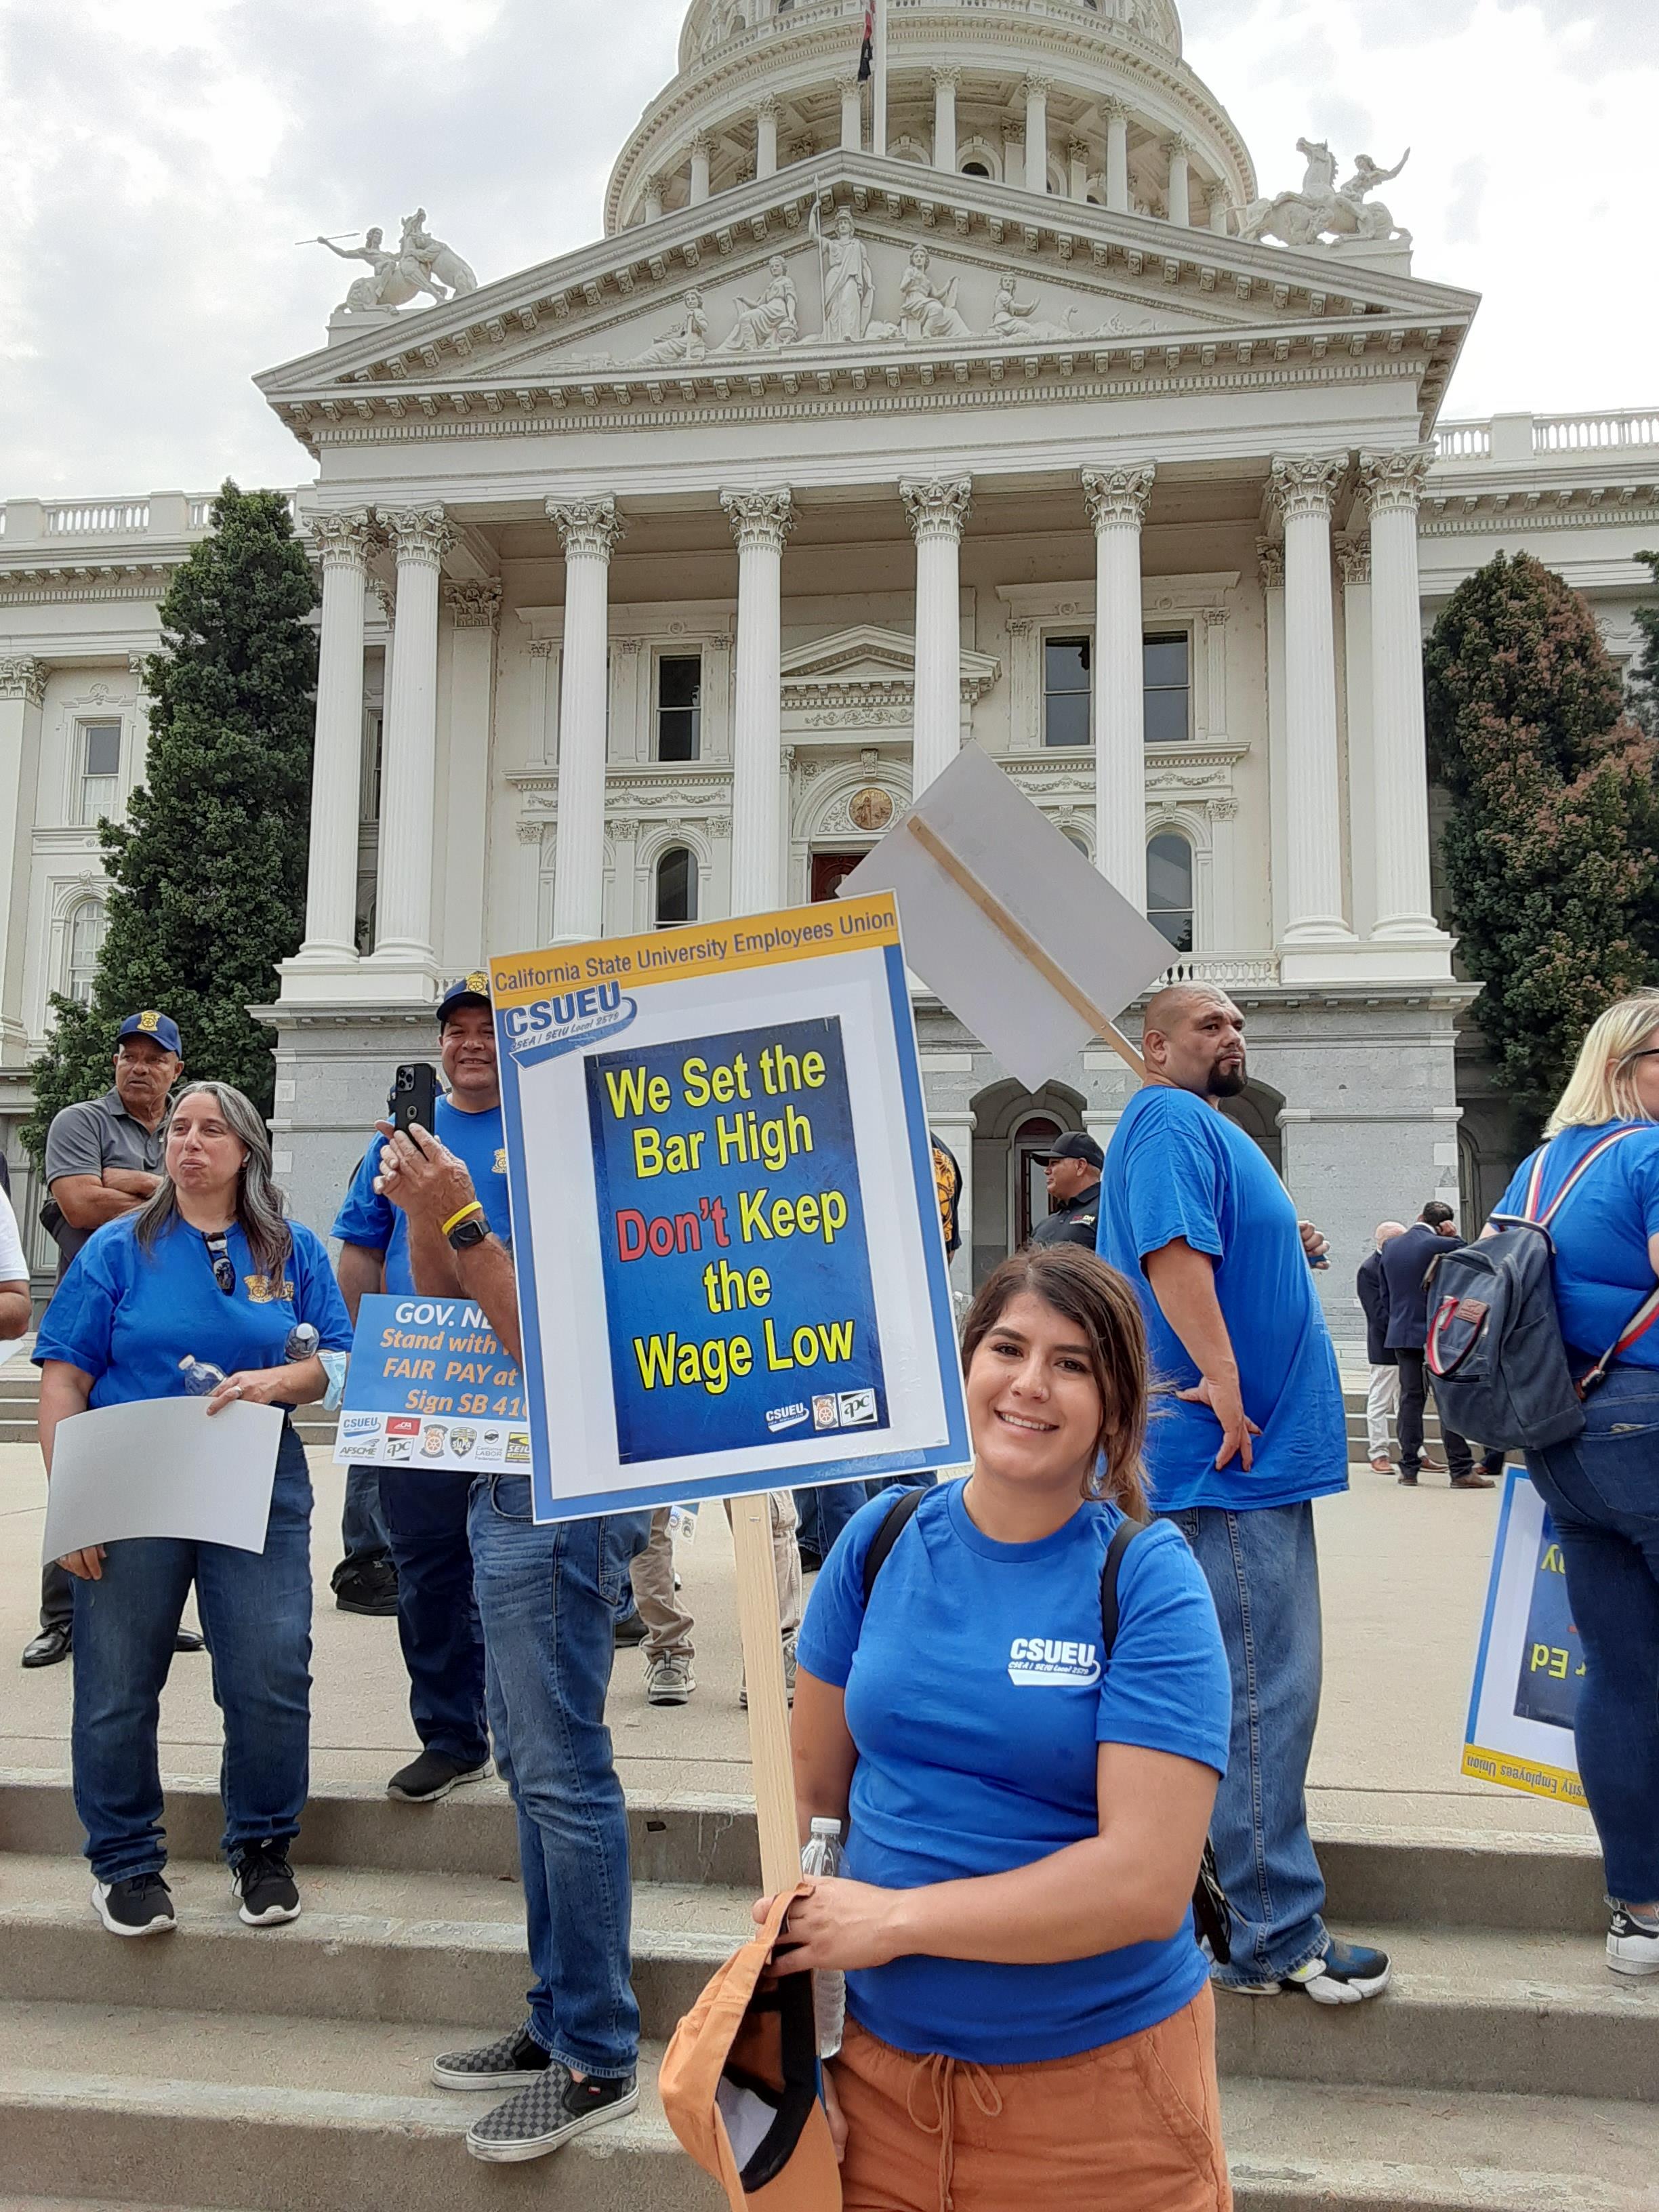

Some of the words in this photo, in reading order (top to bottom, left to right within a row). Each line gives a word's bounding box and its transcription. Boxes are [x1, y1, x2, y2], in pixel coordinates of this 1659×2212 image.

[495, 959, 581, 991] California
[586, 953, 632, 977] State
[638, 937, 727, 969] University
[734, 920, 834, 954] Employees
[839, 910, 895, 935] Union
[506, 981, 621, 1037] CSUEU
[546, 1027, 569, 1041] SEIU
[571, 1019, 594, 1033] Local
[606, 1065, 671, 1120] We
[682, 1051, 752, 1107] Set
[760, 1044, 826, 1096] the
[632, 1126, 705, 1180] Bar
[716, 1105, 814, 1171] High
[616, 1197, 731, 1263] Don't
[738, 1188, 847, 1244] Keep
[703, 1259, 771, 1314] the
[395, 1303, 455, 1327] GOV.
[380, 1328, 445, 1351] Stand
[449, 1333, 497, 1355] with
[634, 1332, 752, 1395] Wage
[762, 1319, 855, 1374] Low
[383, 1357, 436, 1380] FAIR
[445, 1361, 493, 1384] PAY
[493, 1368, 518, 1387] at
[405, 1389, 453, 1414] Sign
[457, 1393, 489, 1414] SB
[766, 1402, 804, 1422] CSUEU
[343, 1417, 378, 1429] CSUEU
[340, 1446, 377, 1456] AFSCME
[1010, 1638, 1095, 1667] CSUEU
[1530, 1643, 1570, 1679] Ed
[1467, 1756, 1496, 1778] Union
[1500, 1766, 1557, 1794] Employees
